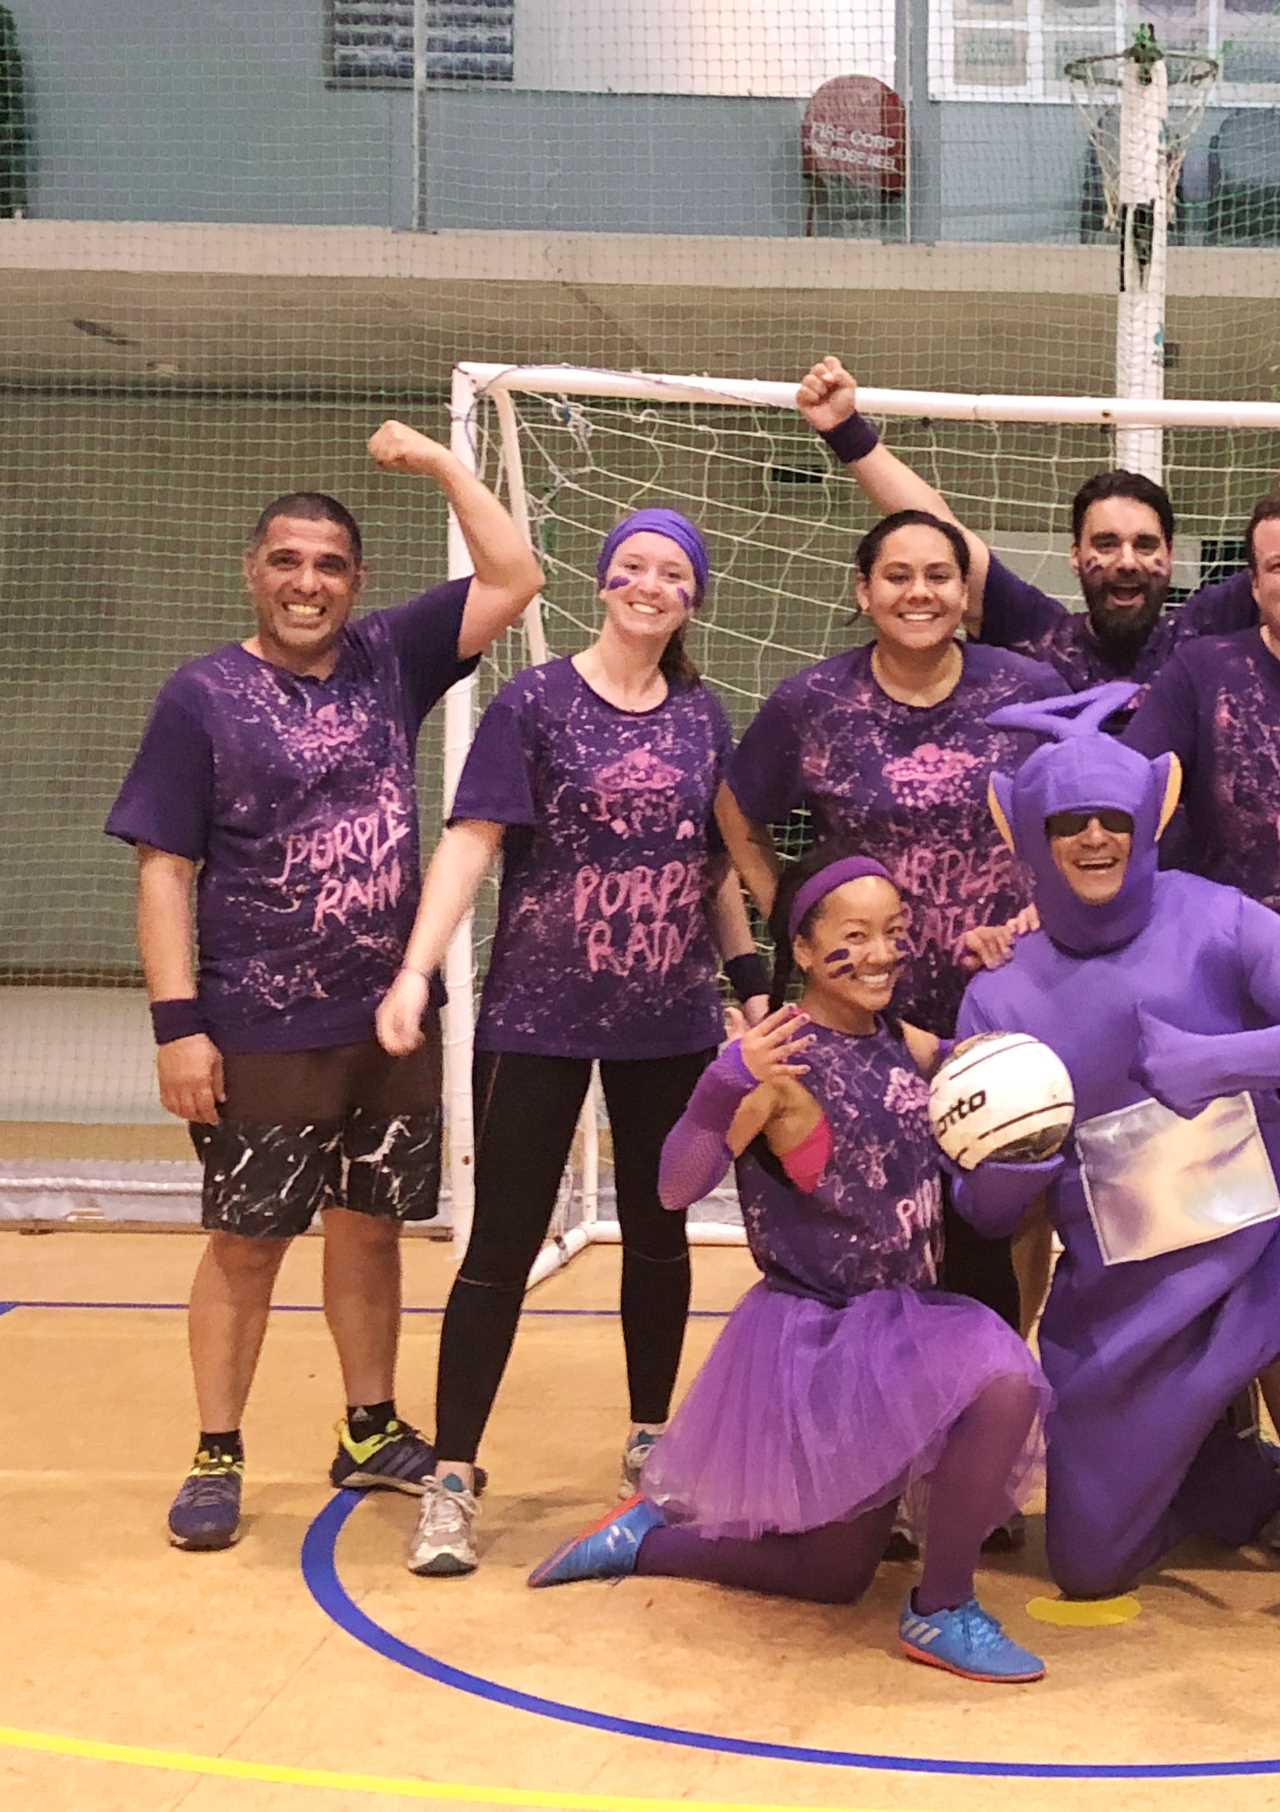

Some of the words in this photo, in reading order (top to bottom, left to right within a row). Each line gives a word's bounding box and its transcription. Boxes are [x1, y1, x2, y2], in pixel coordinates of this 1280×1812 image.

[811, 122, 848, 142] FIRE
[850, 129, 896, 151] CORP
[266, 797, 411, 884] PURPLE
[311, 858, 401, 932] RAIN
[587, 906, 698, 977] RAIN
